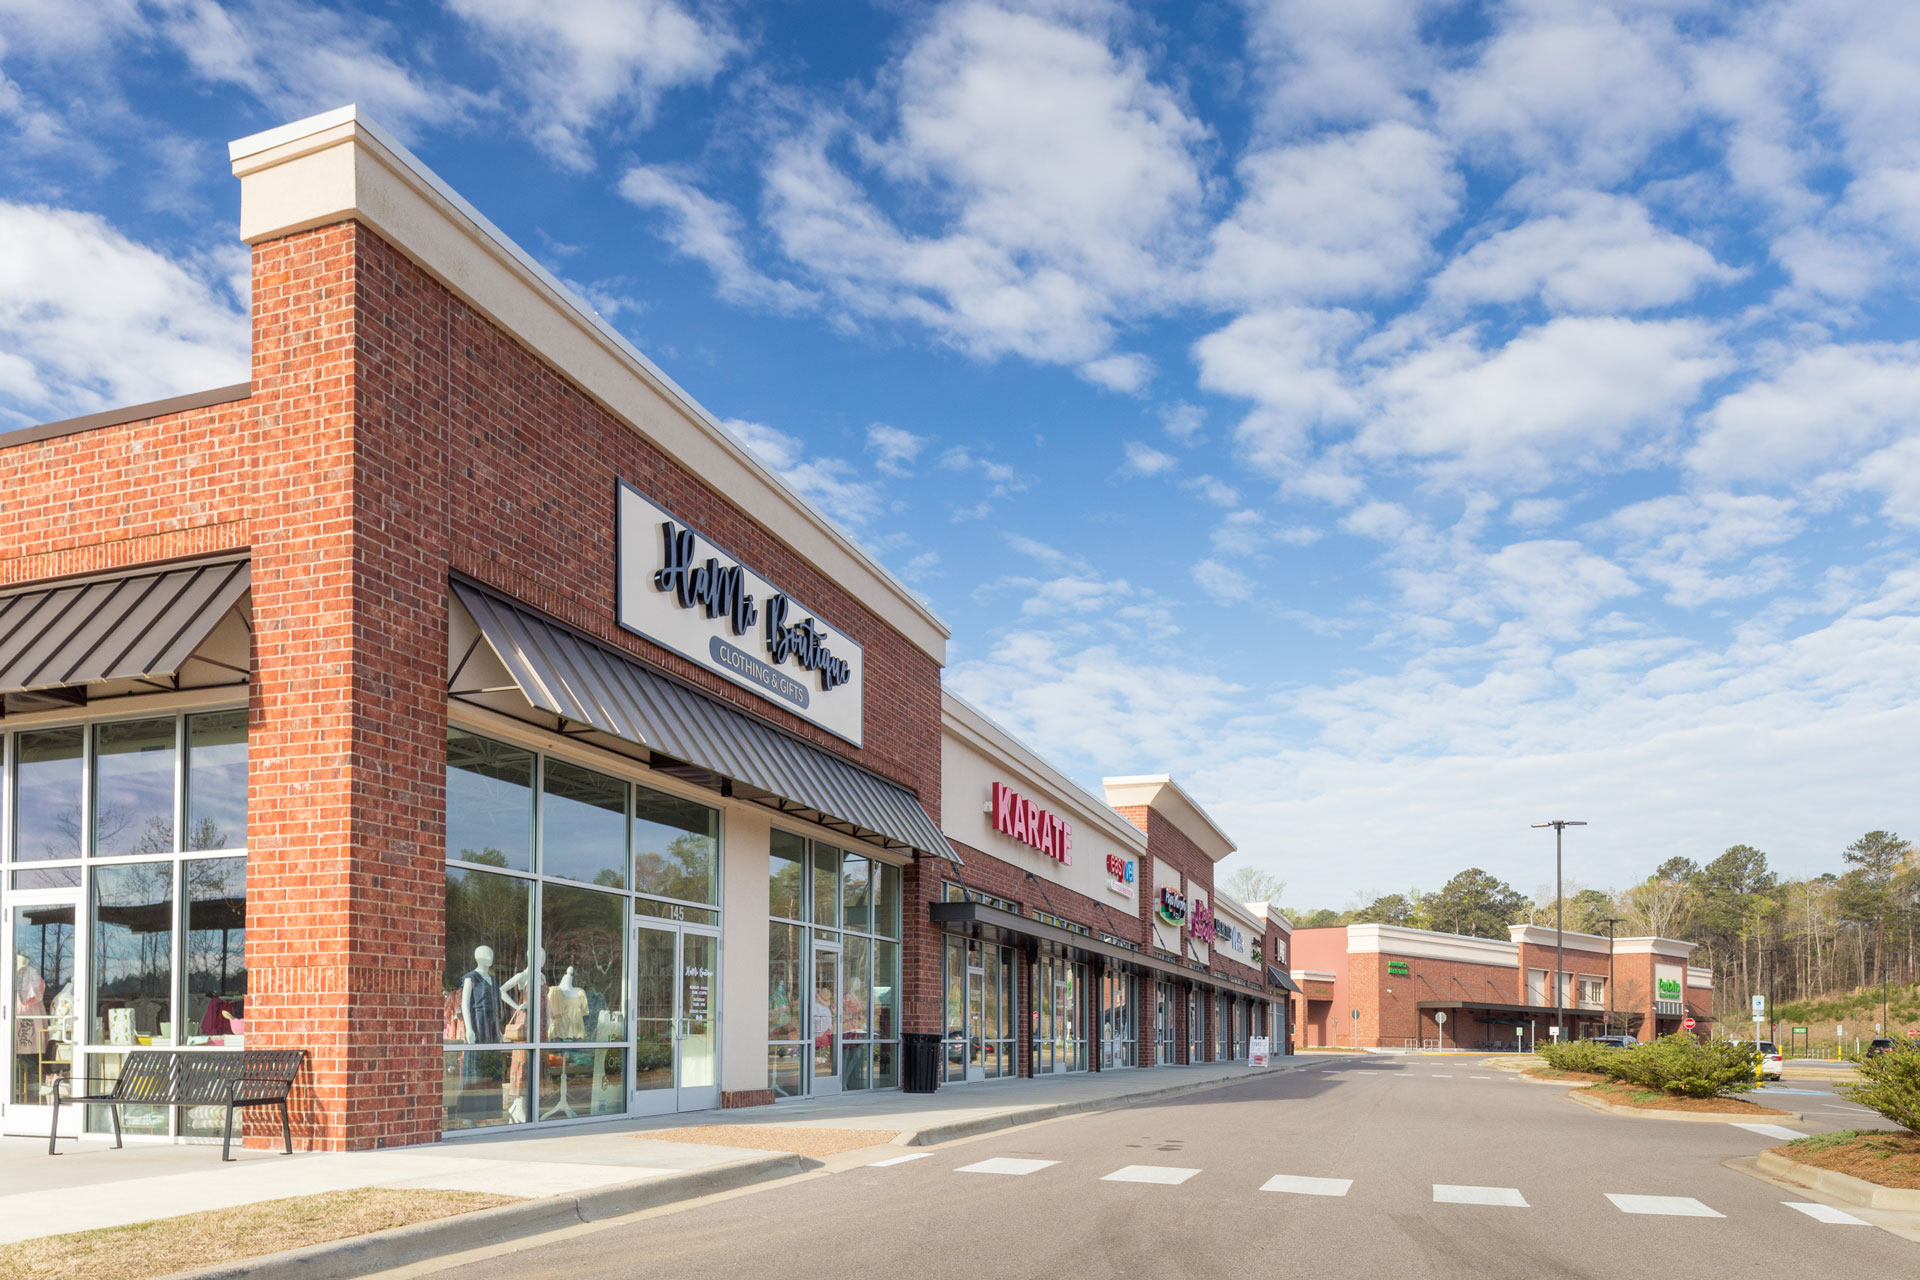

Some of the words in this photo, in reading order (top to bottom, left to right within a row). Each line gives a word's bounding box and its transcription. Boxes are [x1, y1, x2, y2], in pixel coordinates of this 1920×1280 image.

[766, 592, 851, 691] Boutique
[720, 645, 769, 684] CLOTHING
[771, 673, 778, 689] &
[780, 678, 804, 702] GIFTS
[992, 781, 1073, 867] KARATE
[670, 904, 685, 921] 145
[608, 1056, 623, 1069] OPE
